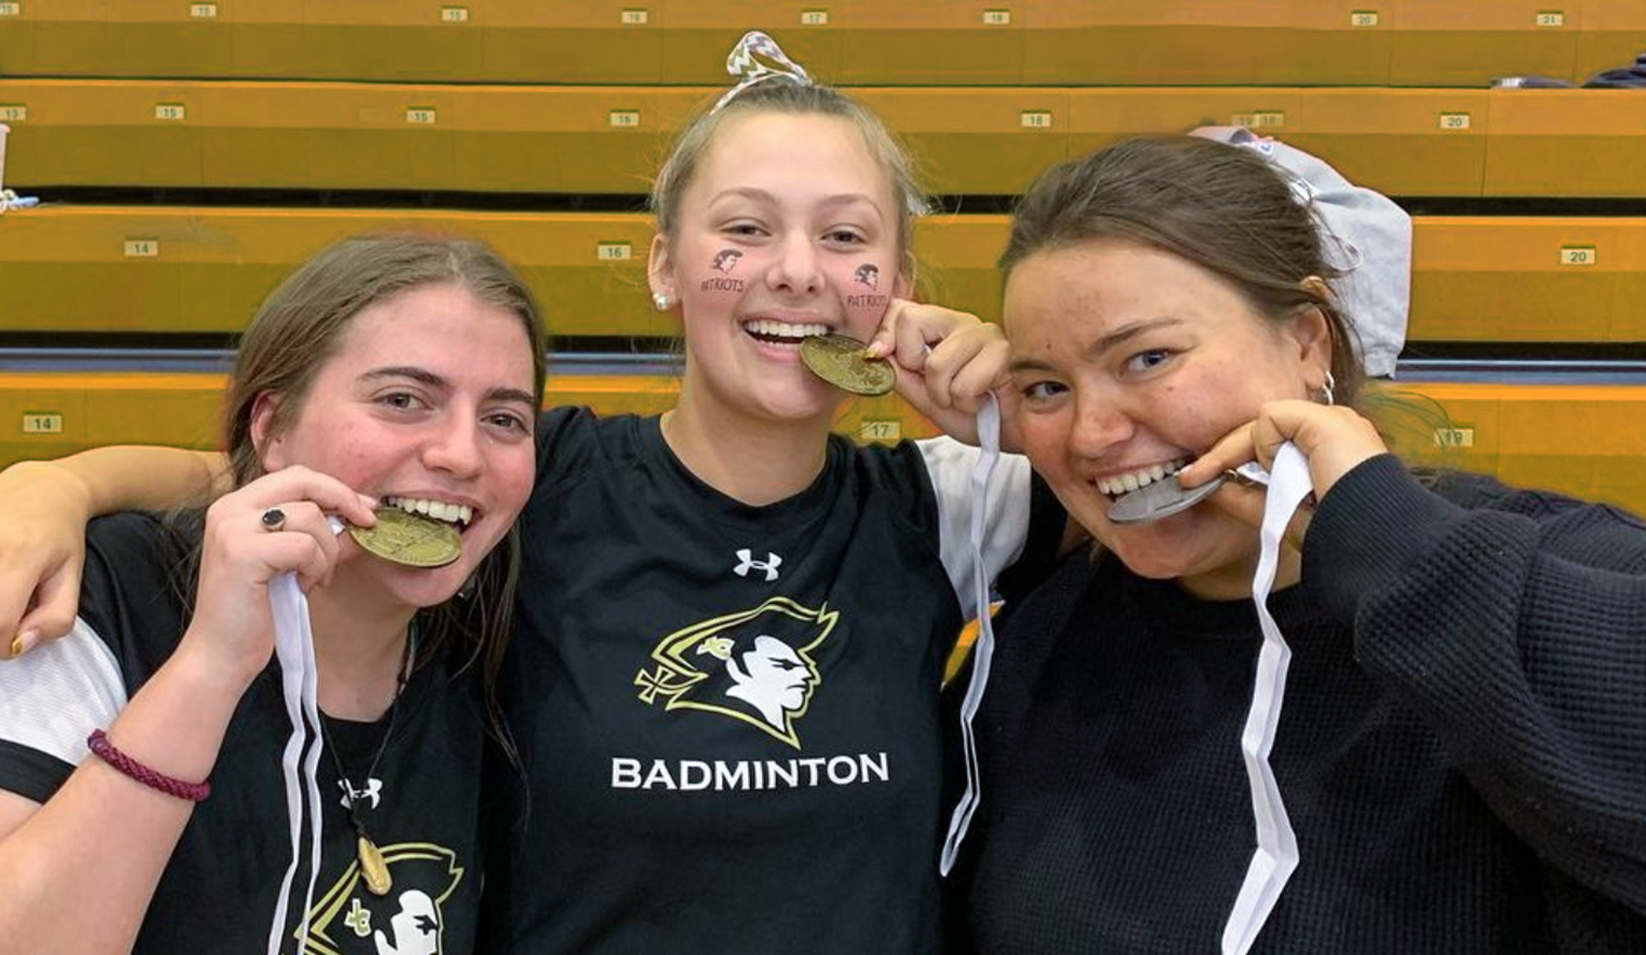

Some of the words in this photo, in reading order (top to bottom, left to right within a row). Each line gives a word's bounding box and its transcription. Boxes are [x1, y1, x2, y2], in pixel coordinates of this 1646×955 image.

[1030, 115, 1042, 125] 18
[1448, 117, 1462, 127] 20
[134, 243, 149, 254] 14
[608, 247, 622, 258] 16
[1570, 251, 1586, 262] 20
[35, 418, 51, 430] 14
[873, 424, 889, 437] 17
[611, 752, 890, 791] BADMINTON
